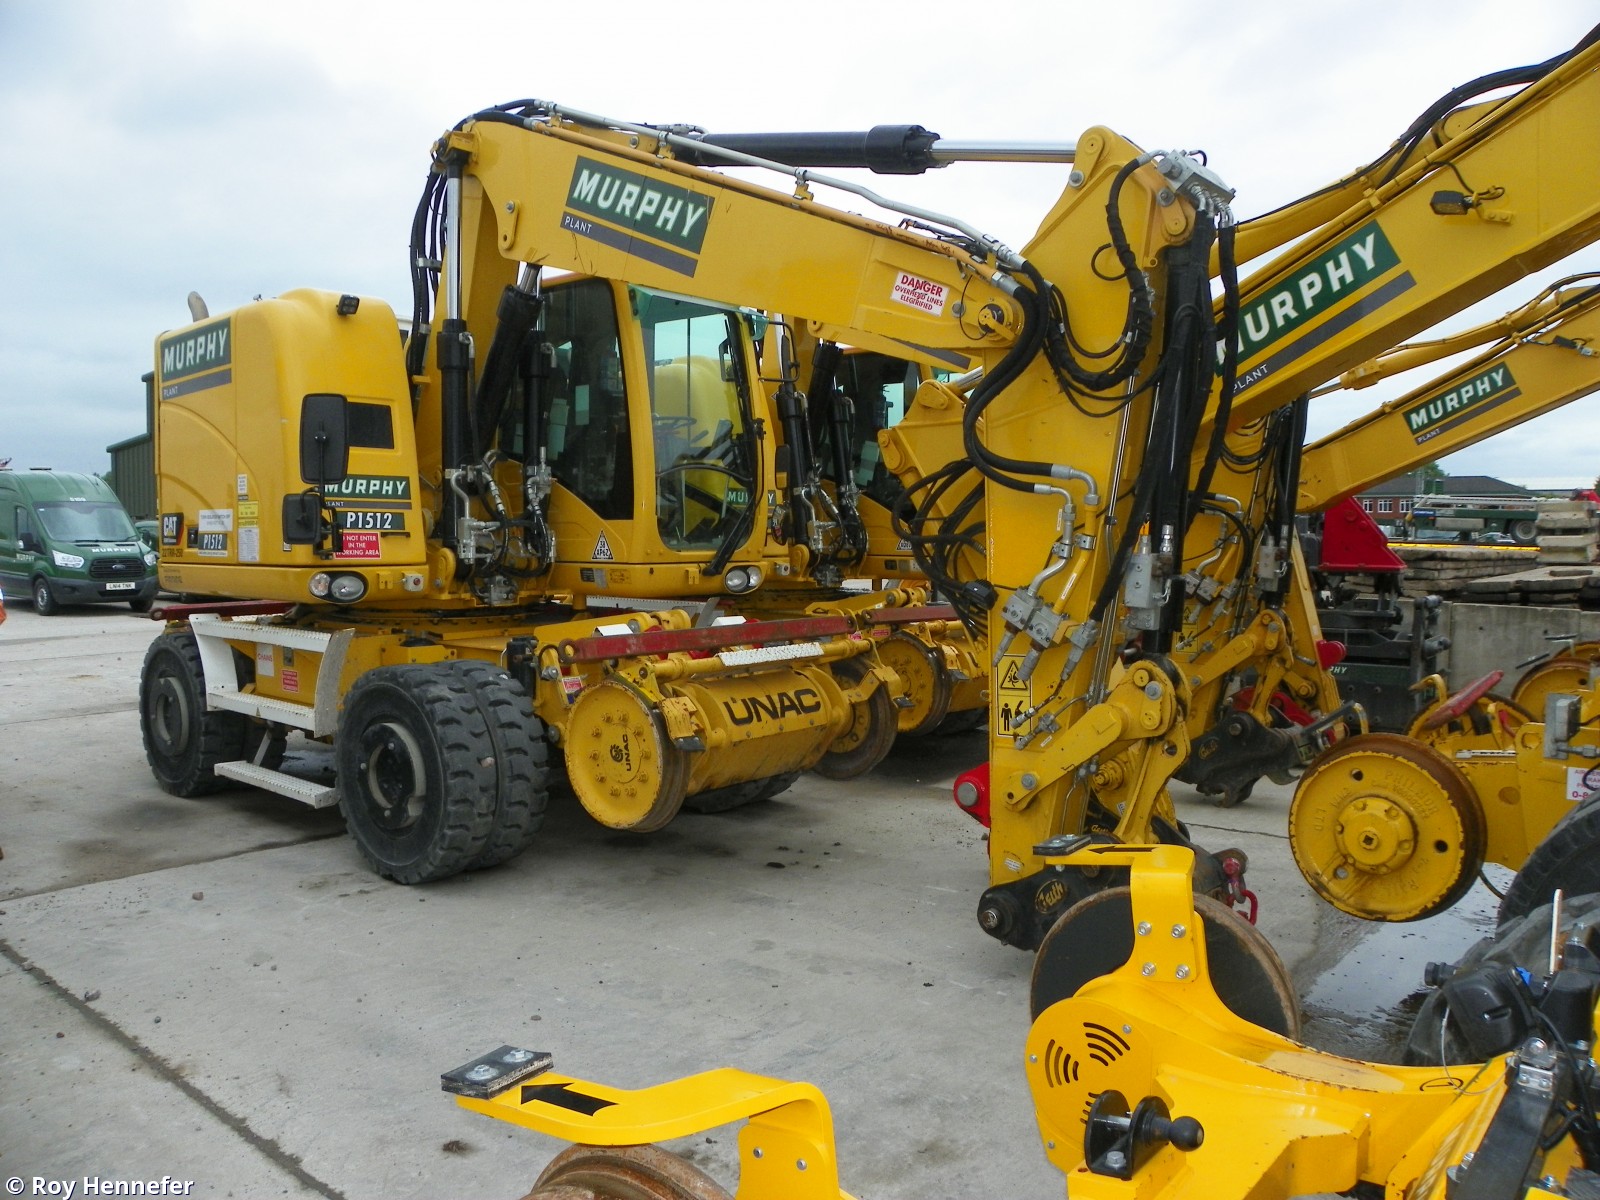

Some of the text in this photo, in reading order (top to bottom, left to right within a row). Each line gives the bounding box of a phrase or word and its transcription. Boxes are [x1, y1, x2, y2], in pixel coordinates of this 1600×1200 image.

[572, 168, 706, 238] MURPHY
[564, 216, 592, 234] PLANT
[900, 274, 943, 297] DANGER
[926, 295, 944, 307] LINES
[163, 328, 228, 374] MURPHY
[163, 385, 178, 397] PLANT
[1410, 367, 1504, 430] MURPHY
[1417, 428, 1440, 443] PLANT
[163, 516, 177, 537] CAT
[346, 511, 392, 529] P1512
[203, 533, 222, 549] P1512
[722, 688, 821, 726] UNAC
[622, 733, 632, 772] UNAC
